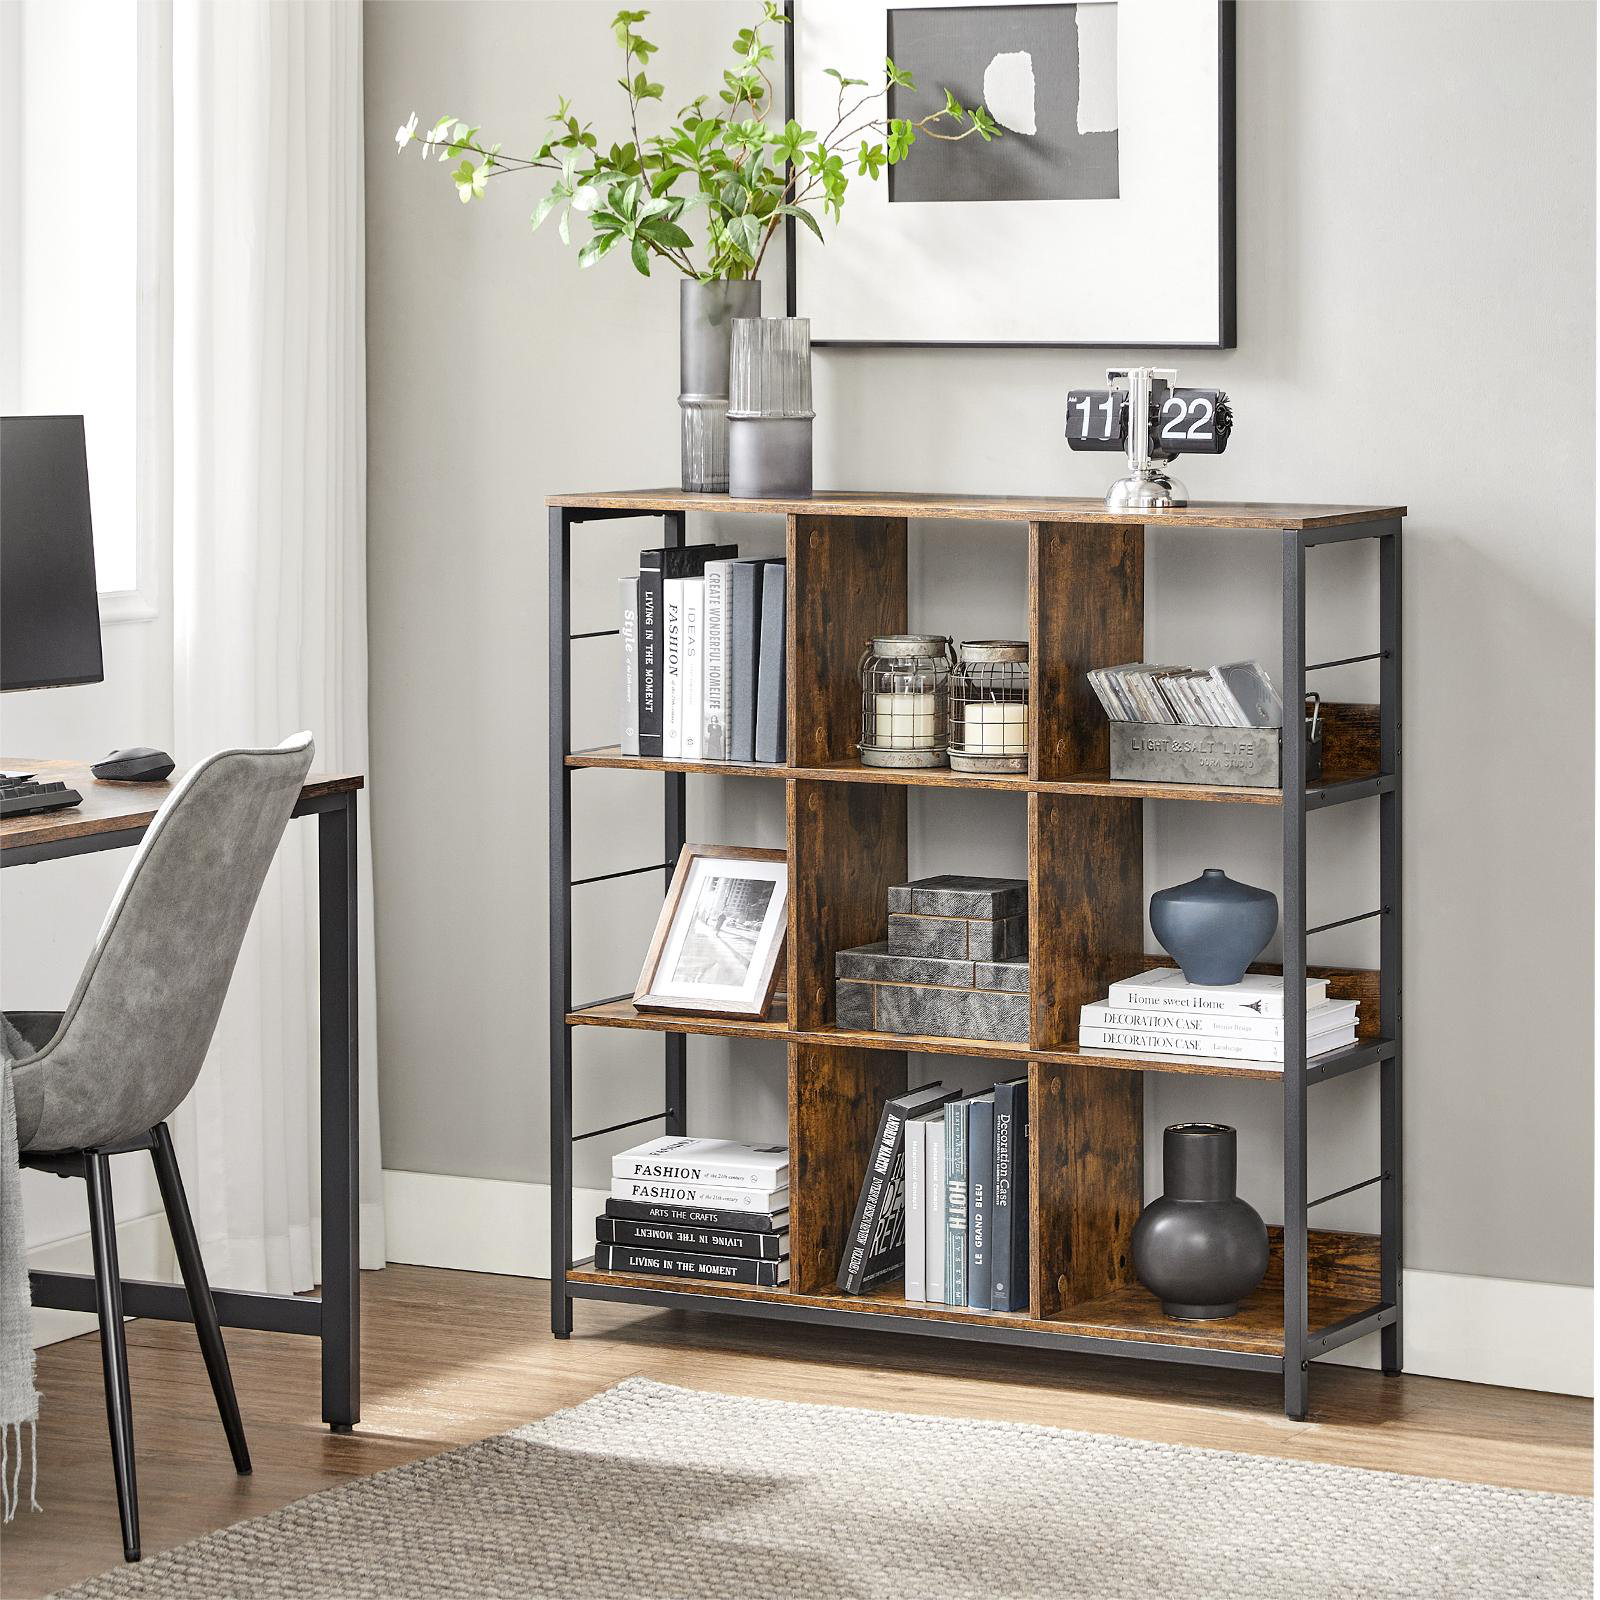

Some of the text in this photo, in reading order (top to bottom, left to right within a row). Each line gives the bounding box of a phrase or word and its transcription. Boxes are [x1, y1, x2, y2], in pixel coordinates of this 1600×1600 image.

[1075, 396, 1213, 440] 11 22
[622, 609, 636, 653] Style
[668, 604, 679, 677] FASHION
[687, 607, 696, 657] IDEAS
[709, 573, 721, 710] CREATE WONDERFUL HOMELIFE
[645, 591, 654, 713] LIVING IN THE MOMENT
[1223, 743, 1254, 756] LIFE
[1128, 993, 1225, 1009] Home sweet Home
[1103, 1012, 1175, 1028] DECORATION
[1175, 1019, 1203, 1031] CASE
[1103, 1032, 1174, 1048] DECORATION
[1175, 1038, 1202, 1051] CASE
[881, 1113, 901, 1148] ANDREW
[633, 1164, 702, 1180] FASHION
[873, 1144, 893, 1175] MARTIN
[1000, 1113, 1011, 1207] Decoration Case
[631, 1185, 697, 1201] FASHION
[649, 1208, 718, 1223] ARTS THE CRAFTS
[975, 1183, 983, 1265] LE GRAND BLEU
[634, 1227, 743, 1248] LIVING IN THE MOMENT
[629, 1256, 738, 1277] LIVING IN THE MOMENT
